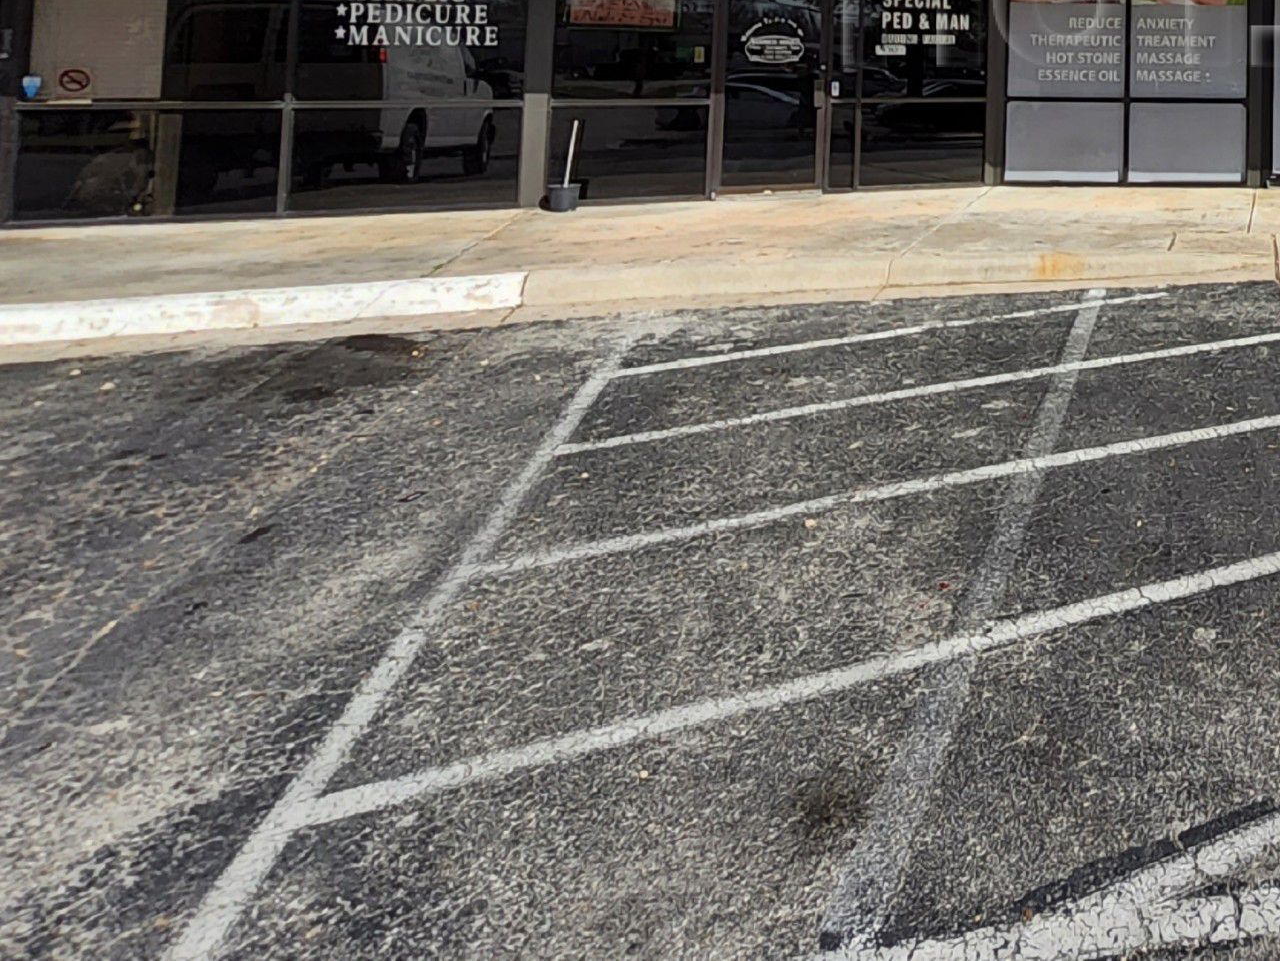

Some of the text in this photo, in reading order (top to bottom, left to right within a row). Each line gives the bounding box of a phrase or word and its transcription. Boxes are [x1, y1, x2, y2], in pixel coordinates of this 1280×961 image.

[349, 3, 488, 24] PEDICURE
[882, 11, 970, 31] PED & MAN
[1069, 17, 1195, 31] REDUCE ANXIETY
[347, 25, 499, 47] MANICURE
[1030, 33, 1216, 48] THERAPEUTIC TREATMENT
[1046, 51, 1201, 65] HOT STONE MASSAGE
[1038, 68, 1201, 83] ESSENCE OIL MASSAGE
